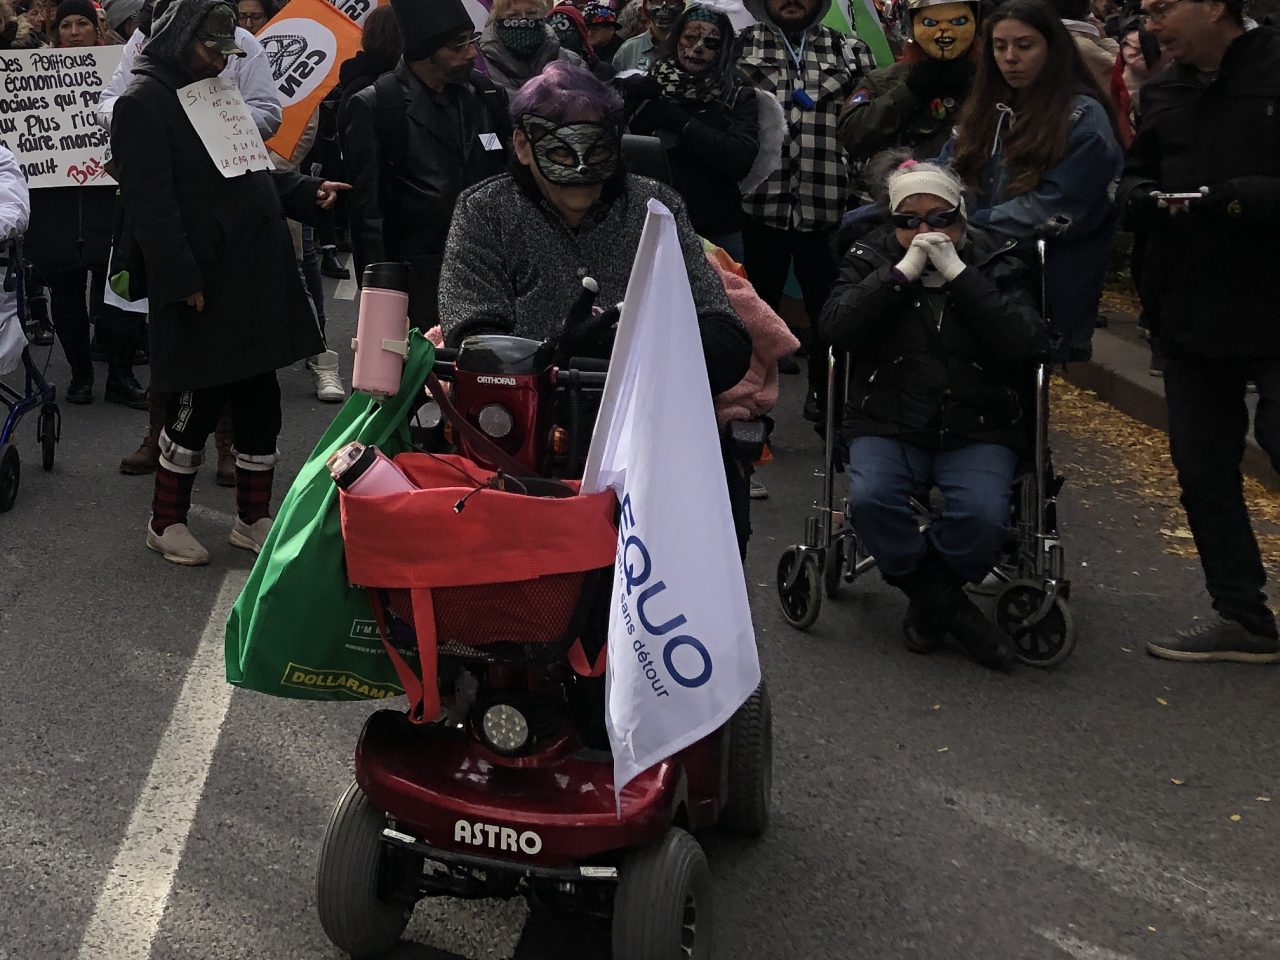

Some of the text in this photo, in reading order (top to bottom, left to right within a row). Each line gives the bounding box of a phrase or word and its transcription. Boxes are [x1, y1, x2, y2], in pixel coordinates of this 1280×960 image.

[54, 91, 78, 112] qui
[477, 376, 517, 386] ORTHOFAB
[620, 592, 670, 698] sans détour
[455, 819, 543, 855] ASTRO
